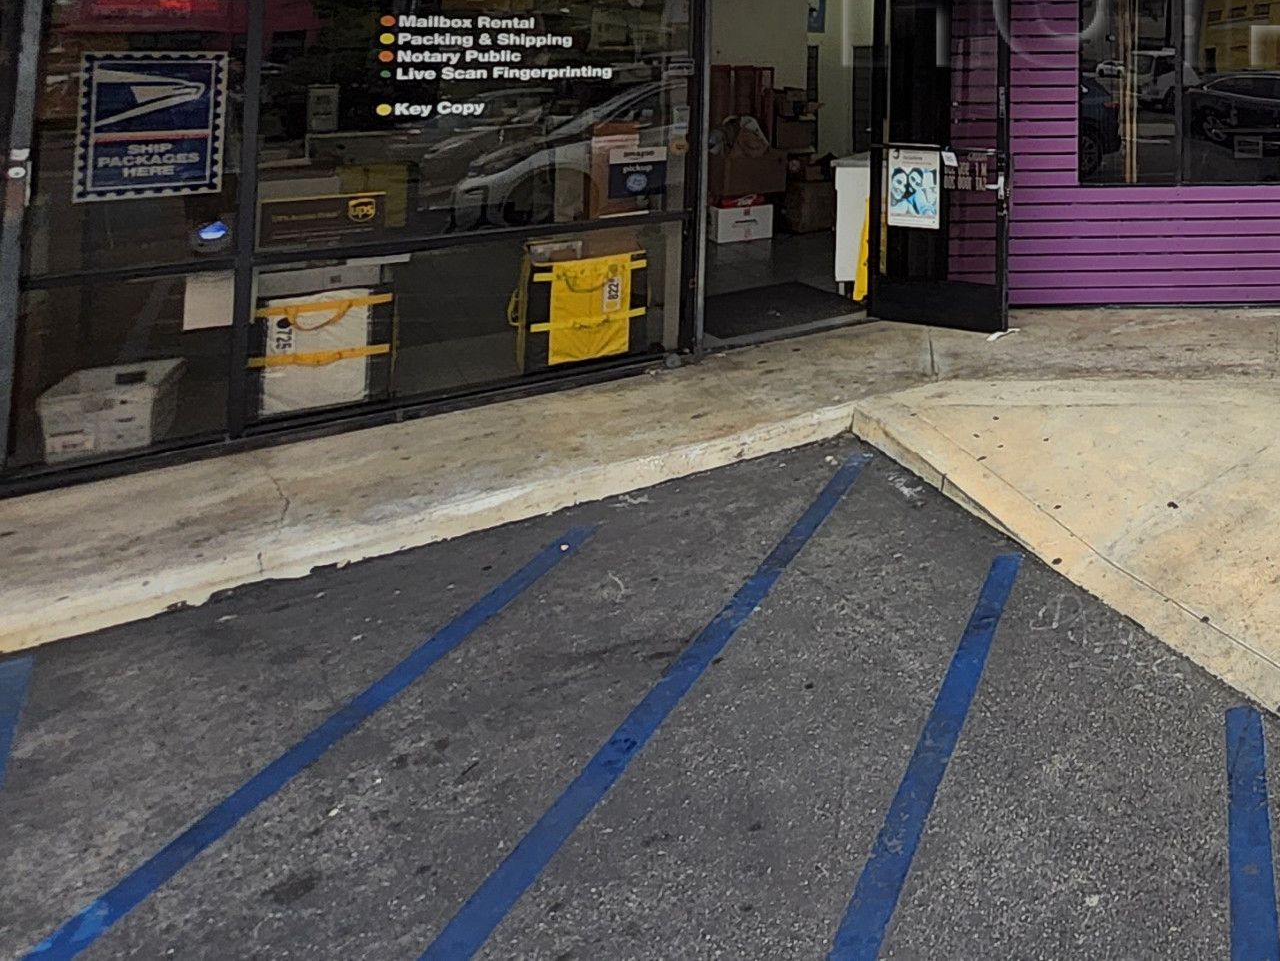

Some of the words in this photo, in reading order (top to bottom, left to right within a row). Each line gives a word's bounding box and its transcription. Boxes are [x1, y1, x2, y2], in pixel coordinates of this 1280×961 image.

[398, 15, 473, 29] Mailbox
[477, 16, 535, 30] Rental
[397, 32, 474, 48] Packing
[478, 33, 492, 46] &
[496, 32, 573, 48] Shipping
[396, 50, 461, 64] Notary
[465, 50, 522, 62] Public
[396, 67, 437, 80] Live
[441, 66, 488, 80] Scan
[492, 65, 613, 81] Fingerprinting
[394, 102, 432, 117] Key
[436, 101, 485, 116] Copy
[127, 142, 173, 155] SHIP
[97, 152, 200, 167] PACKAGES
[122, 165, 176, 178] HERE
[350, 204, 375, 220] ups
